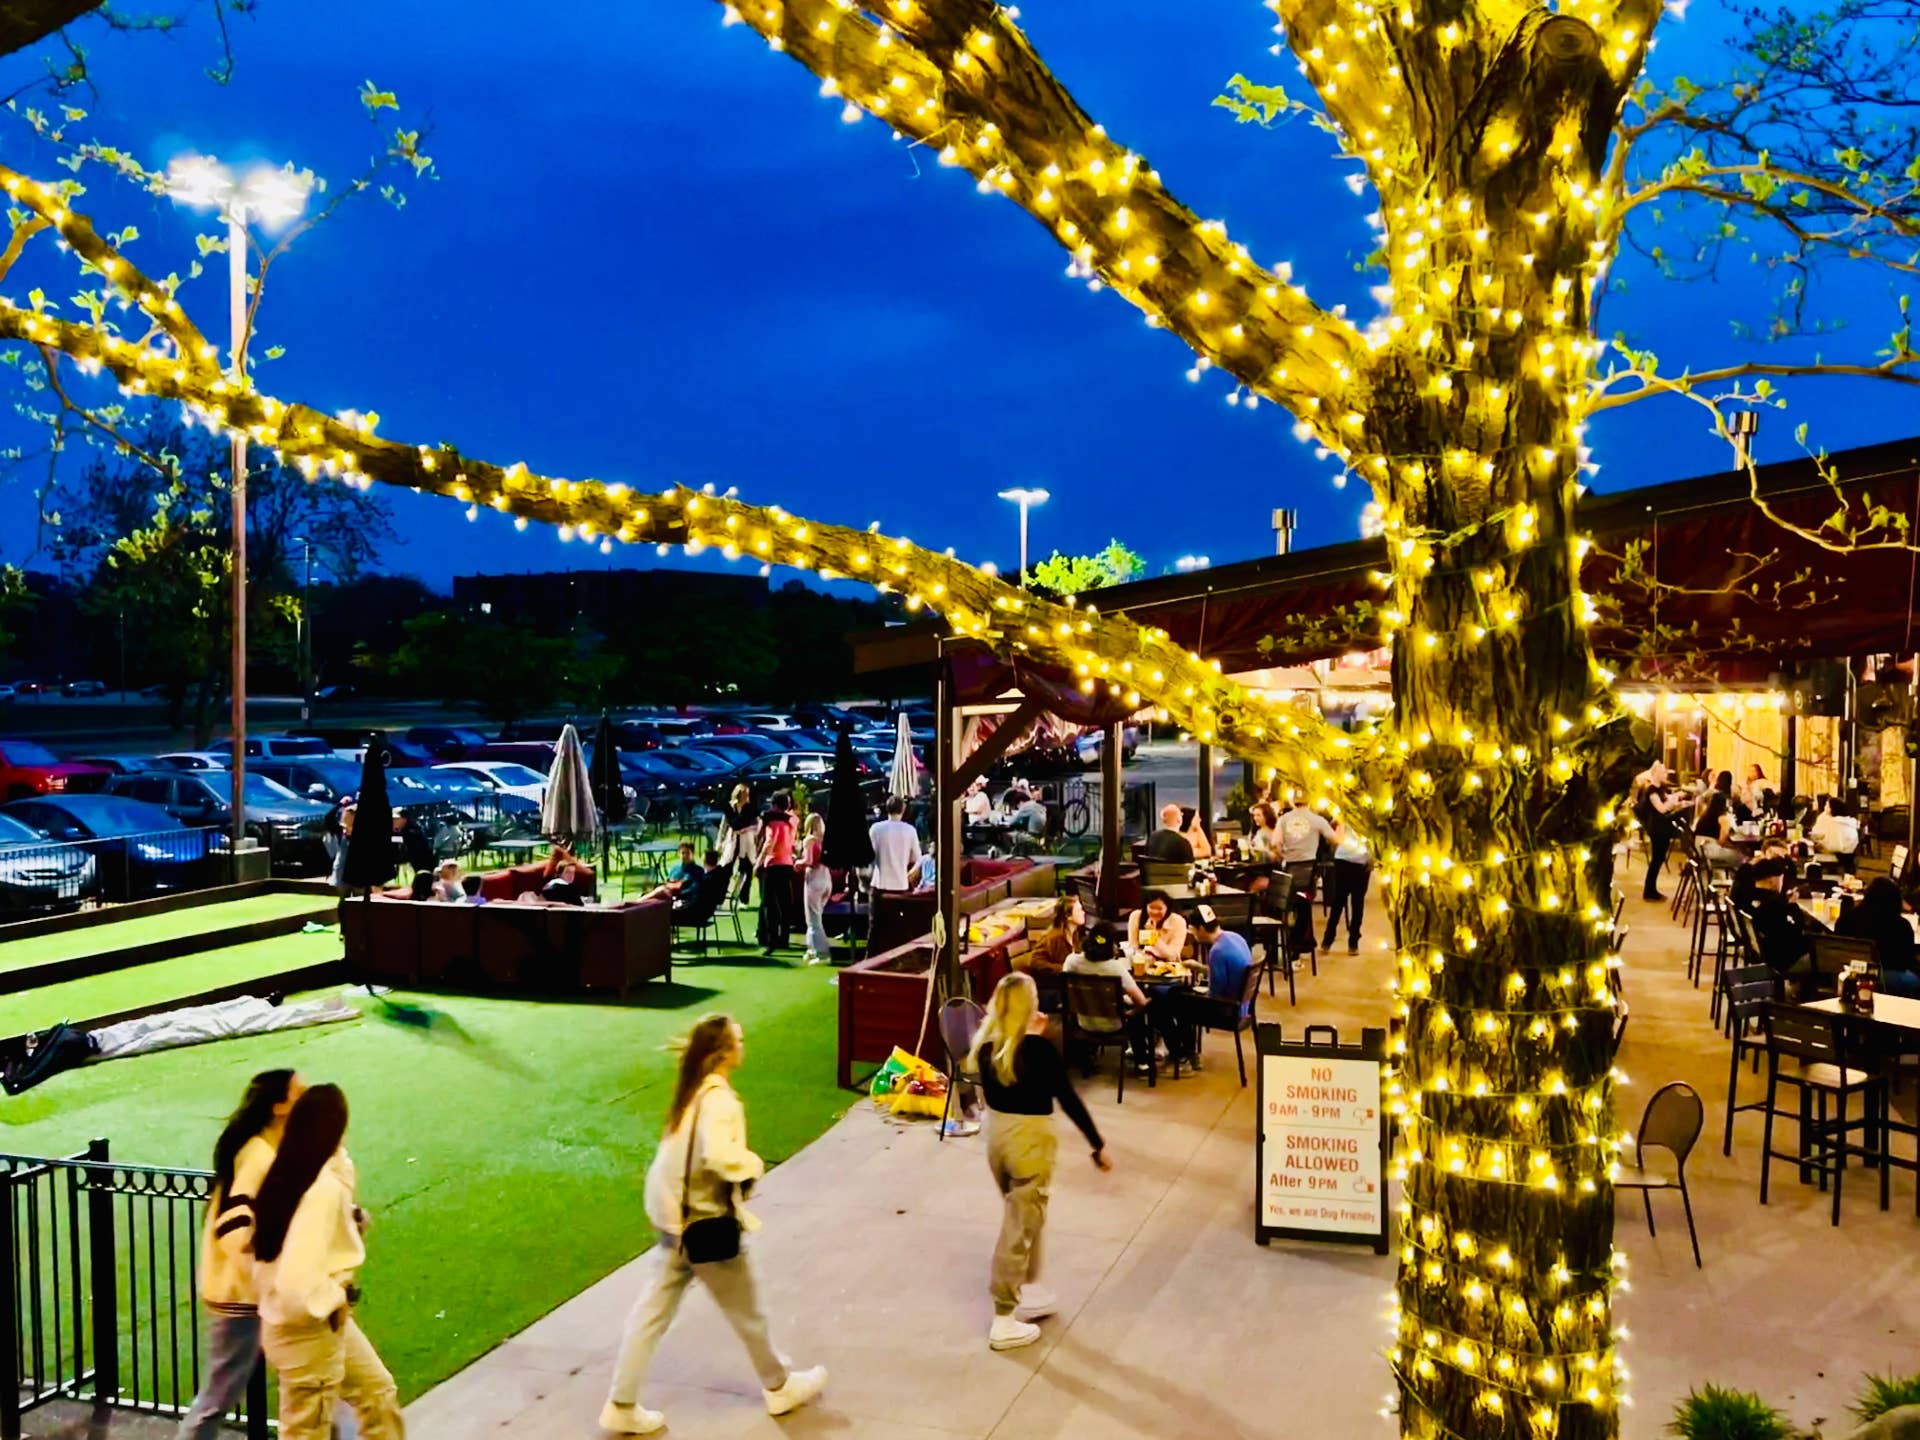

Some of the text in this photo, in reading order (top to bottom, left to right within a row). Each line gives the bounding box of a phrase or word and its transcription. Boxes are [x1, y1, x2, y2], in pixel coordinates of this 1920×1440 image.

[1311, 1068, 1332, 1081] NO
[1286, 1085, 1357, 1102] SMOKING
[1286, 1135, 1358, 1153] SMOKING
[1285, 1154, 1359, 1172] ALLOWED
[1270, 1173, 1302, 1188] After
[1320, 1208, 1337, 1220] Dog
